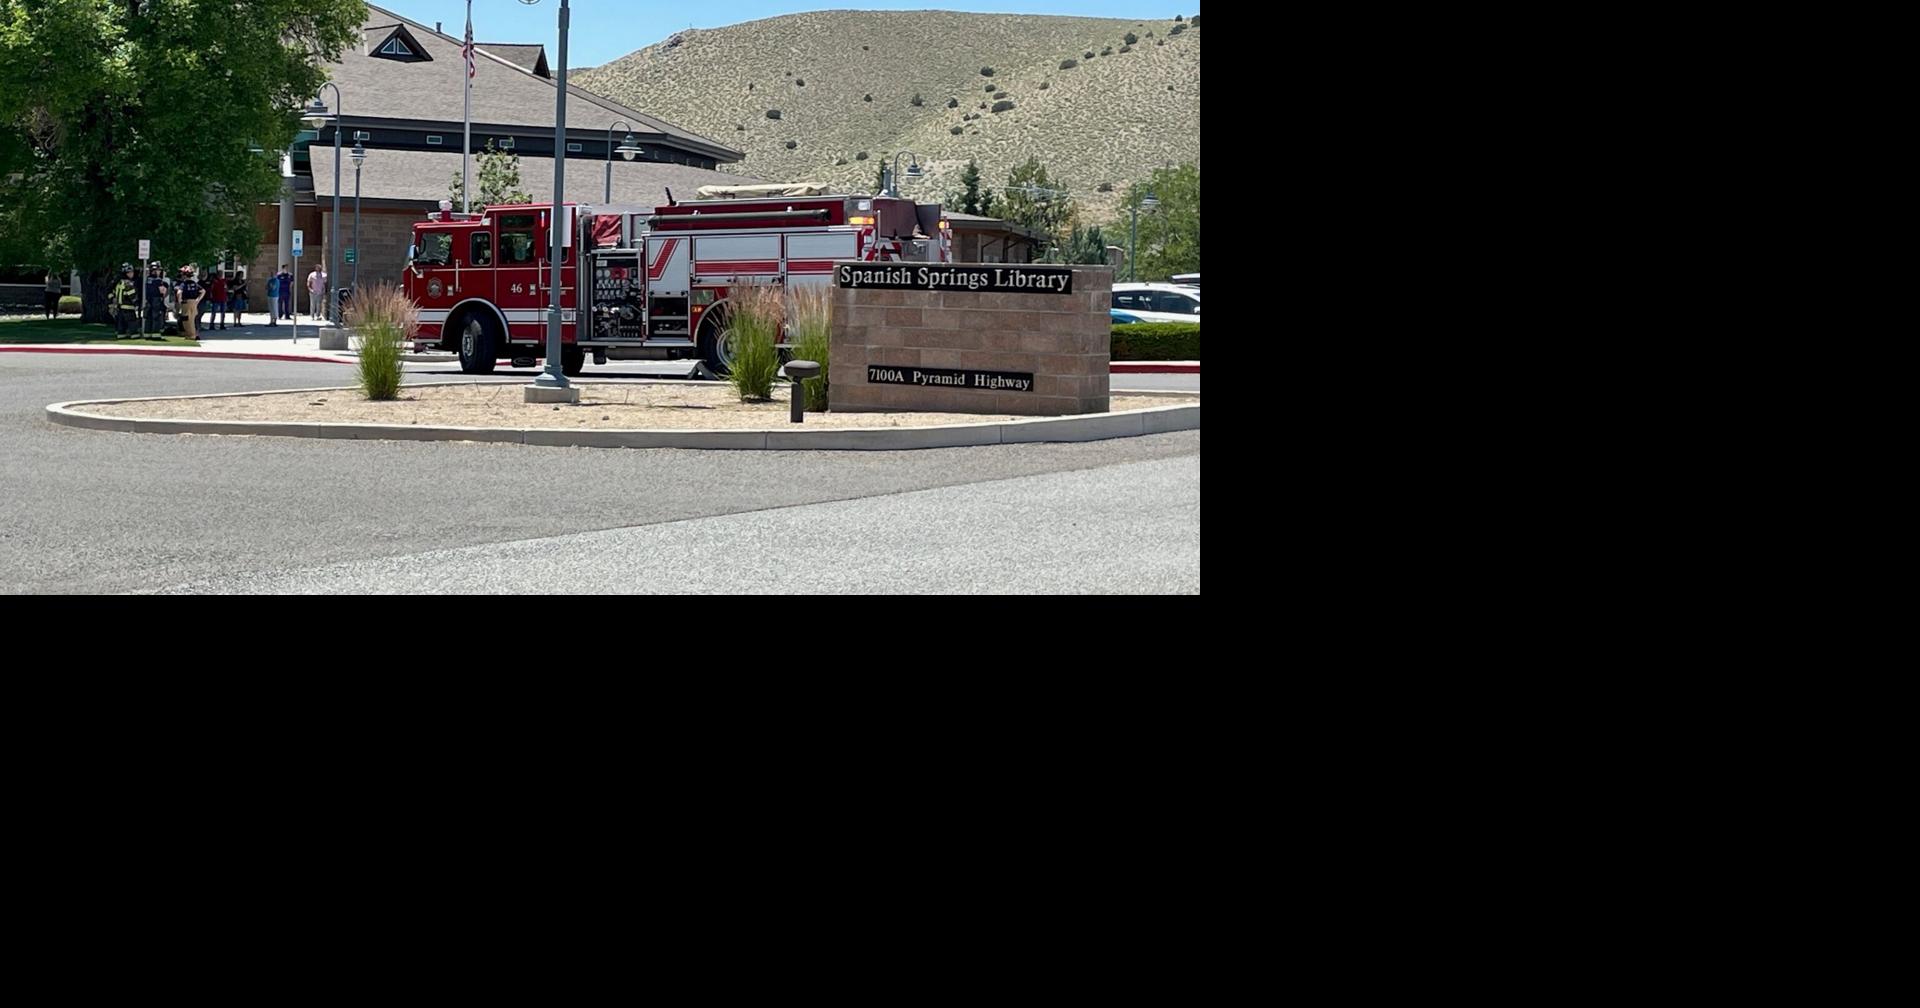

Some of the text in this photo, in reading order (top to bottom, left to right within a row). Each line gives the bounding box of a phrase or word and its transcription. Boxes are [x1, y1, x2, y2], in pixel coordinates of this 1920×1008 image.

[511, 283, 523, 293] 46
[841, 265, 1069, 291] Spanish Springs Library
[868, 368, 1030, 390] 7100A Pyramid Highway
